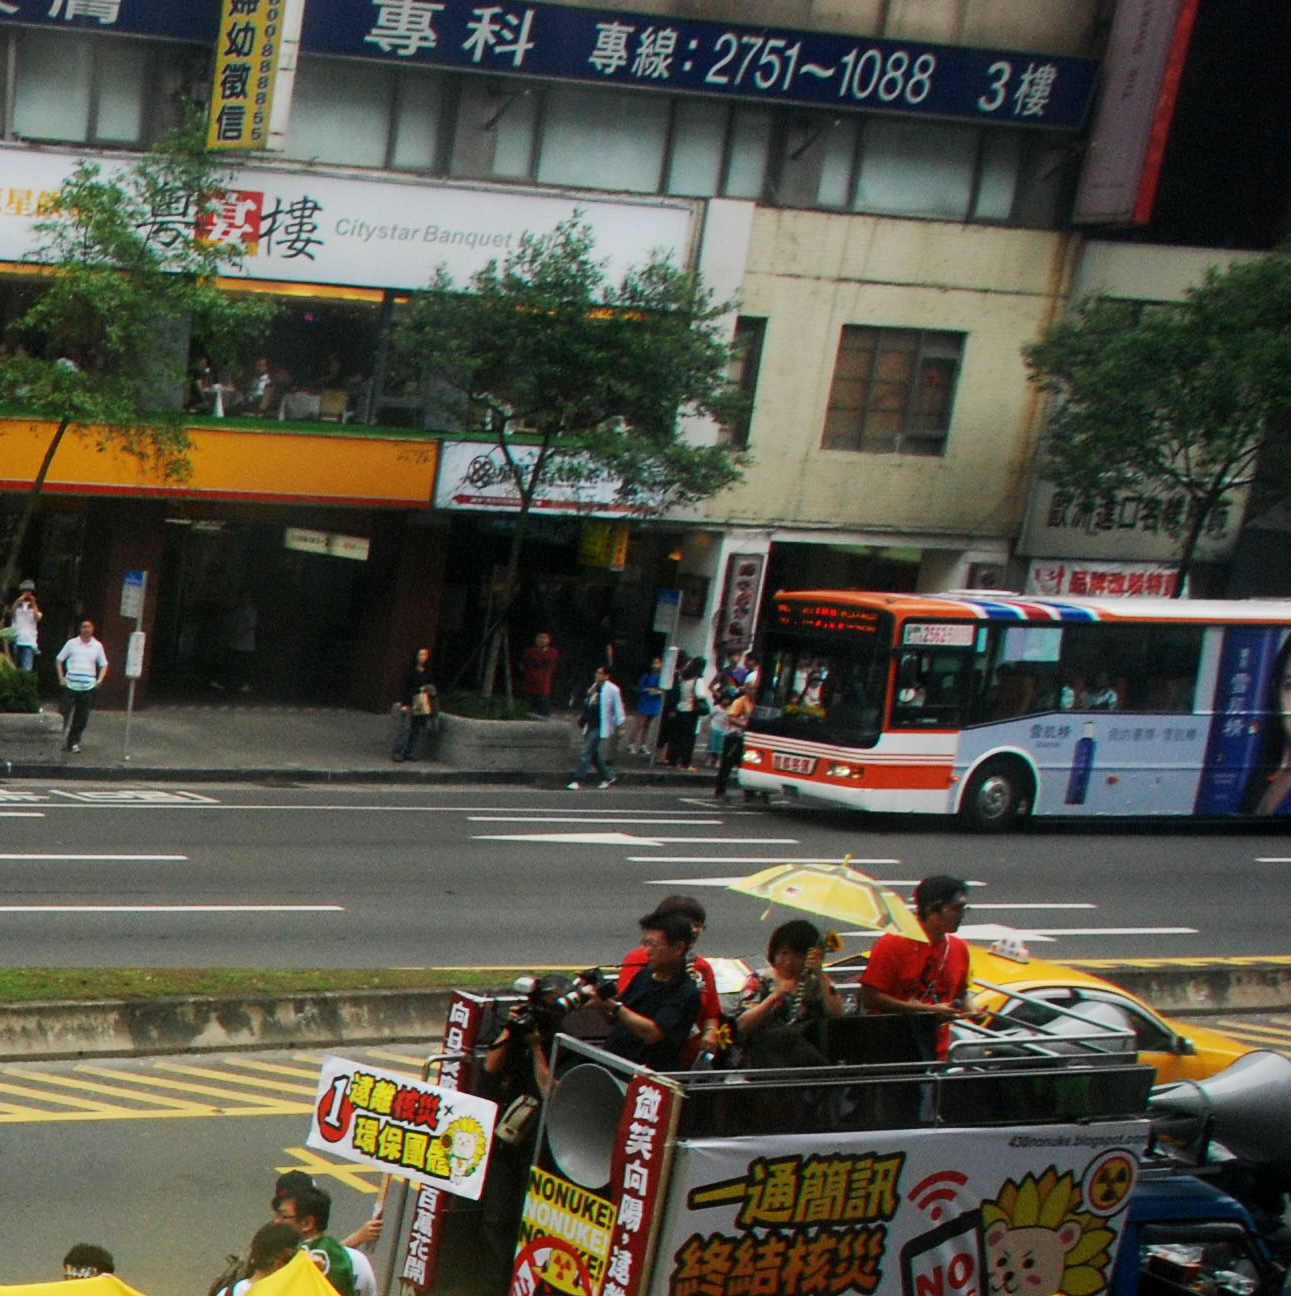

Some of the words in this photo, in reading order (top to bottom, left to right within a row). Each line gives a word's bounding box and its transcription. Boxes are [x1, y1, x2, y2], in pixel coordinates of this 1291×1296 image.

[979, 61, 1060, 119] 3樓
[335, 217, 420, 241] Citystar
[422, 225, 512, 251] Banquet
[349, 1070, 443, 1131] 遠離核災
[529, 1170, 615, 1231] NONUKE!
[687, 1151, 906, 1230] 一通簡訊
[523, 1195, 611, 1256] NONUKE!
